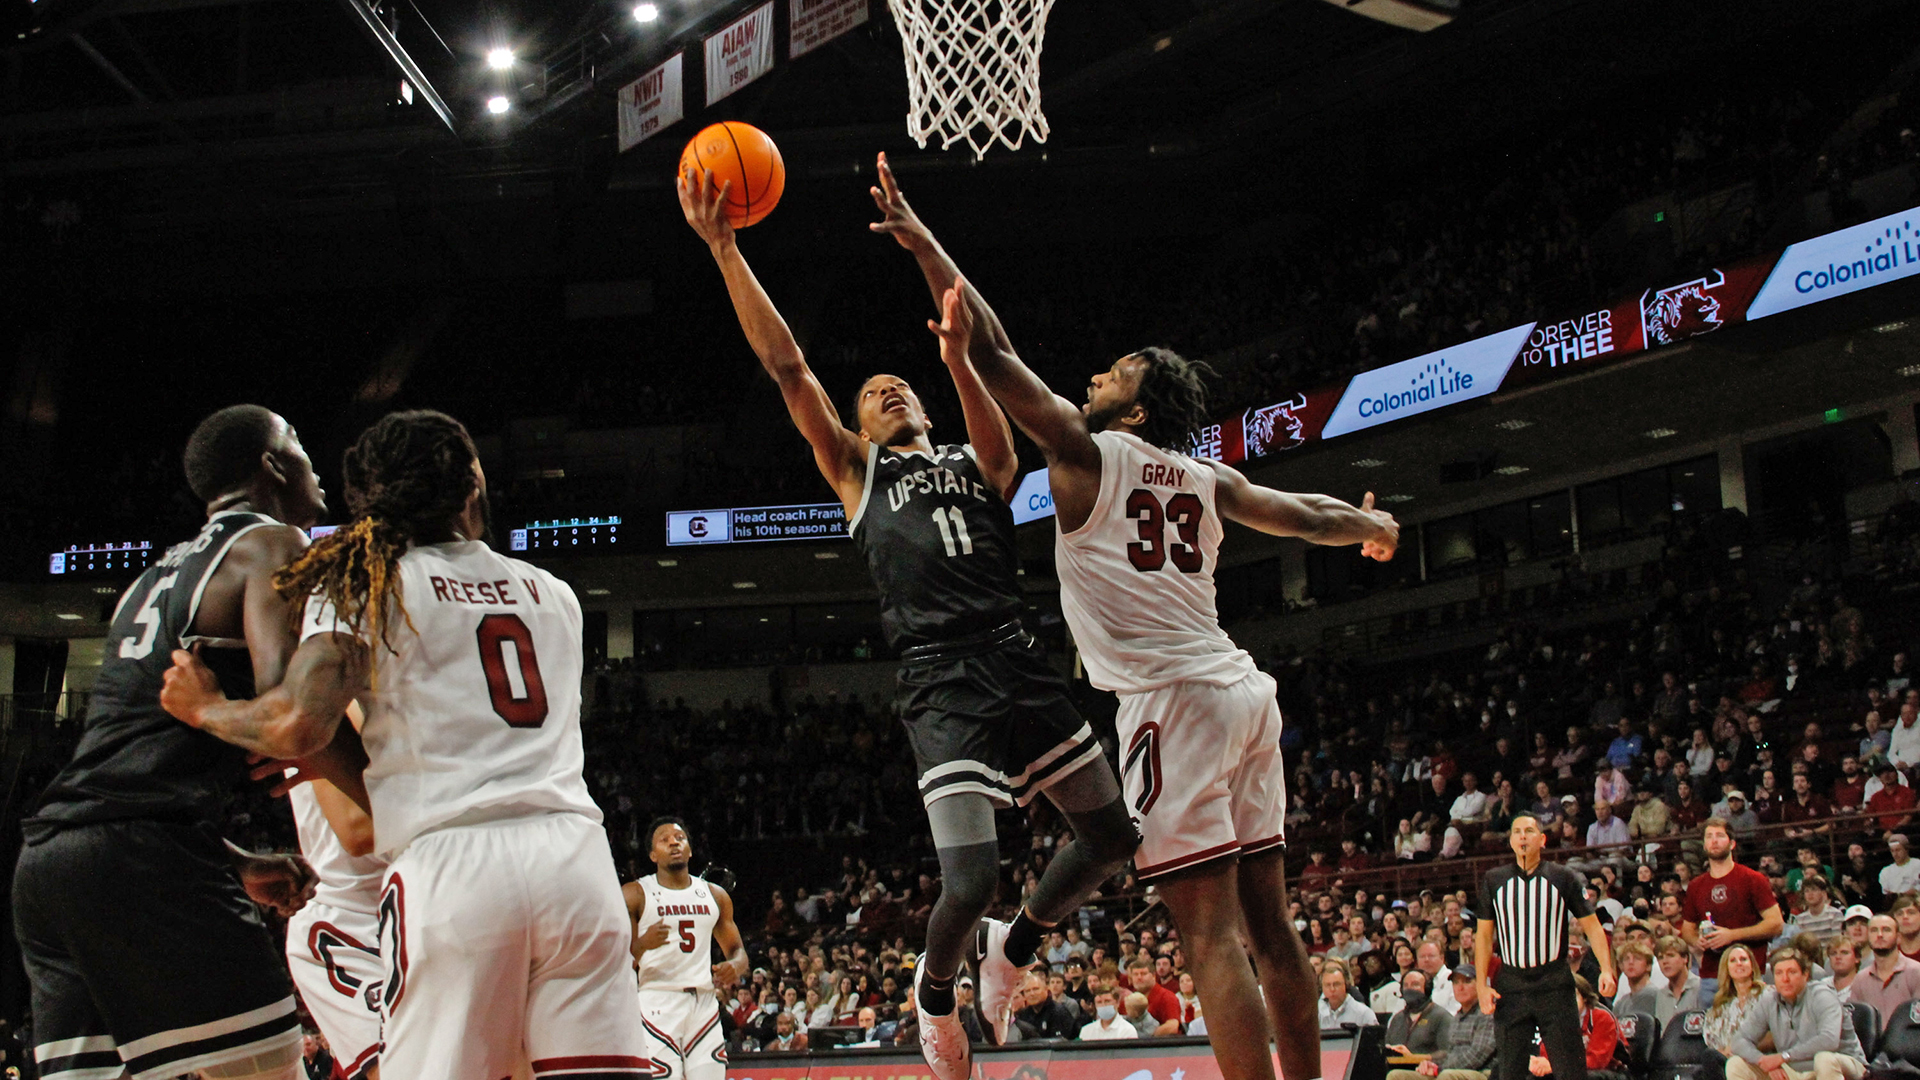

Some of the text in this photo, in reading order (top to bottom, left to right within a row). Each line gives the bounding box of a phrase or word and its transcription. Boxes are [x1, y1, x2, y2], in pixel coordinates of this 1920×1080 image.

[721, 16, 756, 59] AIAW
[633, 68, 665, 107] NWIT
[1795, 245, 1898, 294] Colonial
[1522, 327, 1615, 368] TO THEE
[1530, 309, 1612, 348] OREVER
[1358, 371, 1473, 418] Colonial Life
[1190, 424, 1222, 446] VER
[1192, 440, 1223, 461] EE
[1142, 463, 1186, 487] GRAY
[735, 508, 845, 523] Head coach Frank
[1029, 490, 1052, 511] Col
[735, 520, 842, 537] his 10th season at
[931, 505, 974, 558] 11
[1125, 488, 1204, 574] 33
[430, 575, 541, 605] REESE V
[119, 570, 180, 661] 5
[476, 613, 549, 729] 0
[657, 904, 711, 917] CAROLINA
[678, 920, 696, 953] 5
